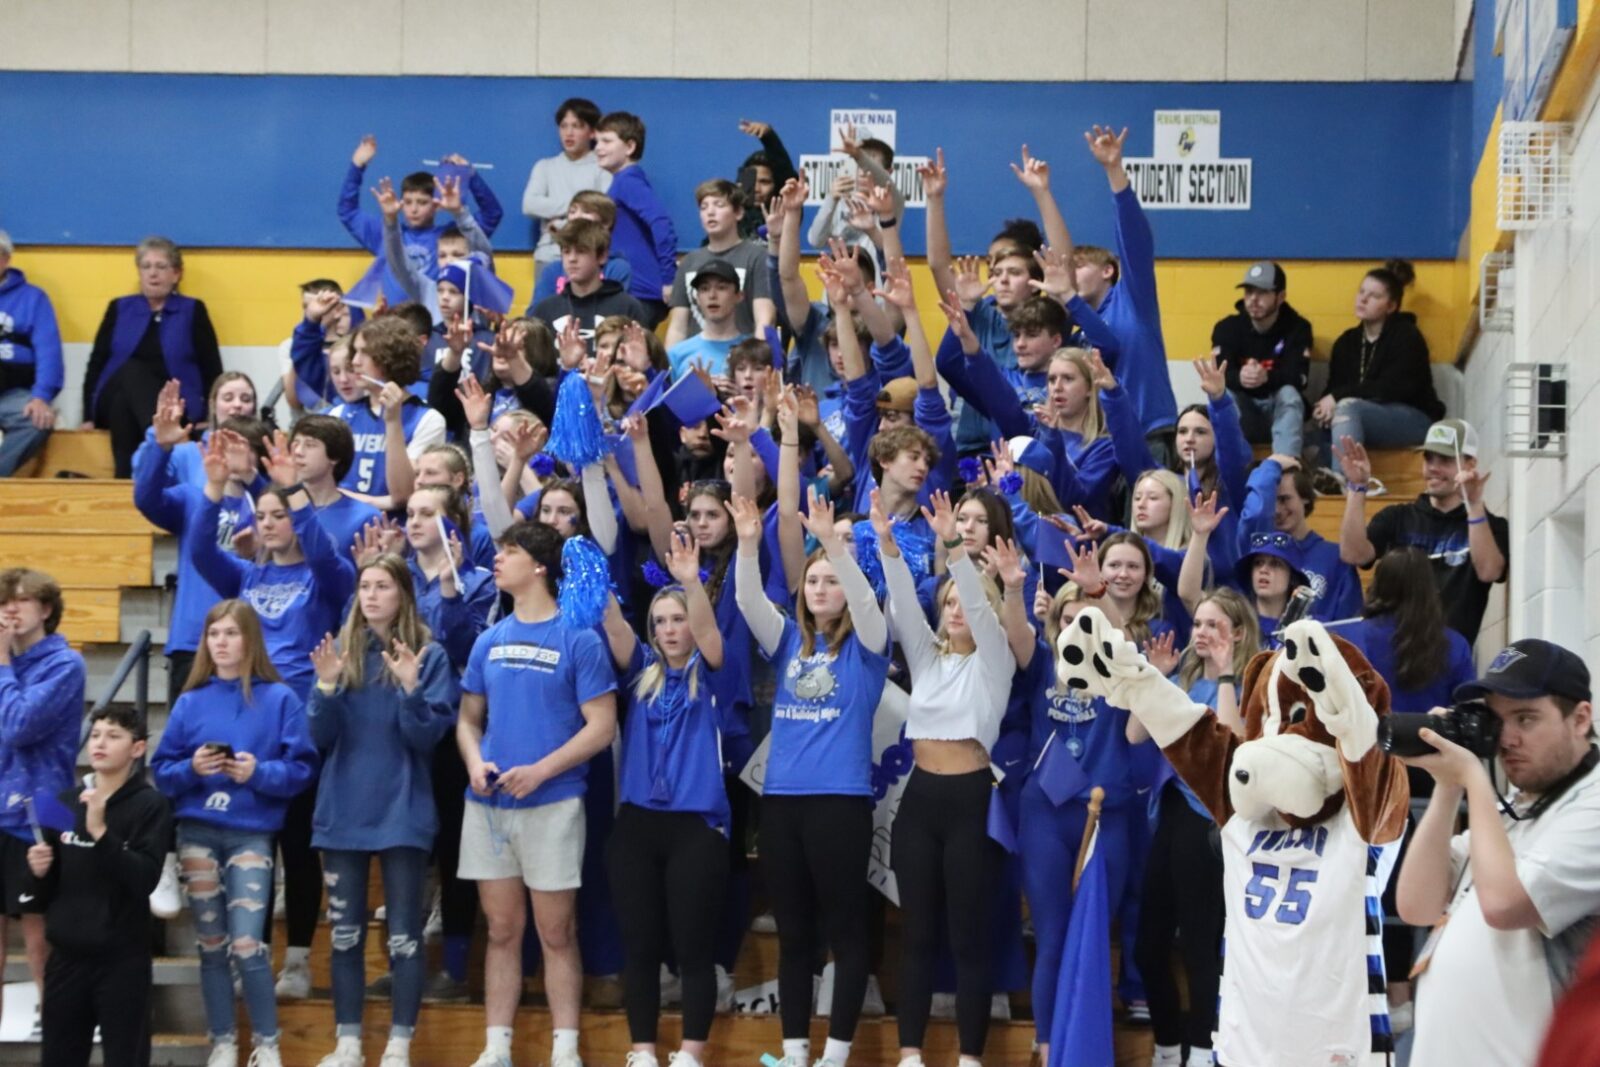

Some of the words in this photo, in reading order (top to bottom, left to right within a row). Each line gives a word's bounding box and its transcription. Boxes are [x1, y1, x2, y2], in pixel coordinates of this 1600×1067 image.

[833, 113, 894, 124] RAVENNA
[1189, 163, 1248, 204] SECTION
[357, 458, 375, 492] 5
[1244, 861, 1319, 925] 55
